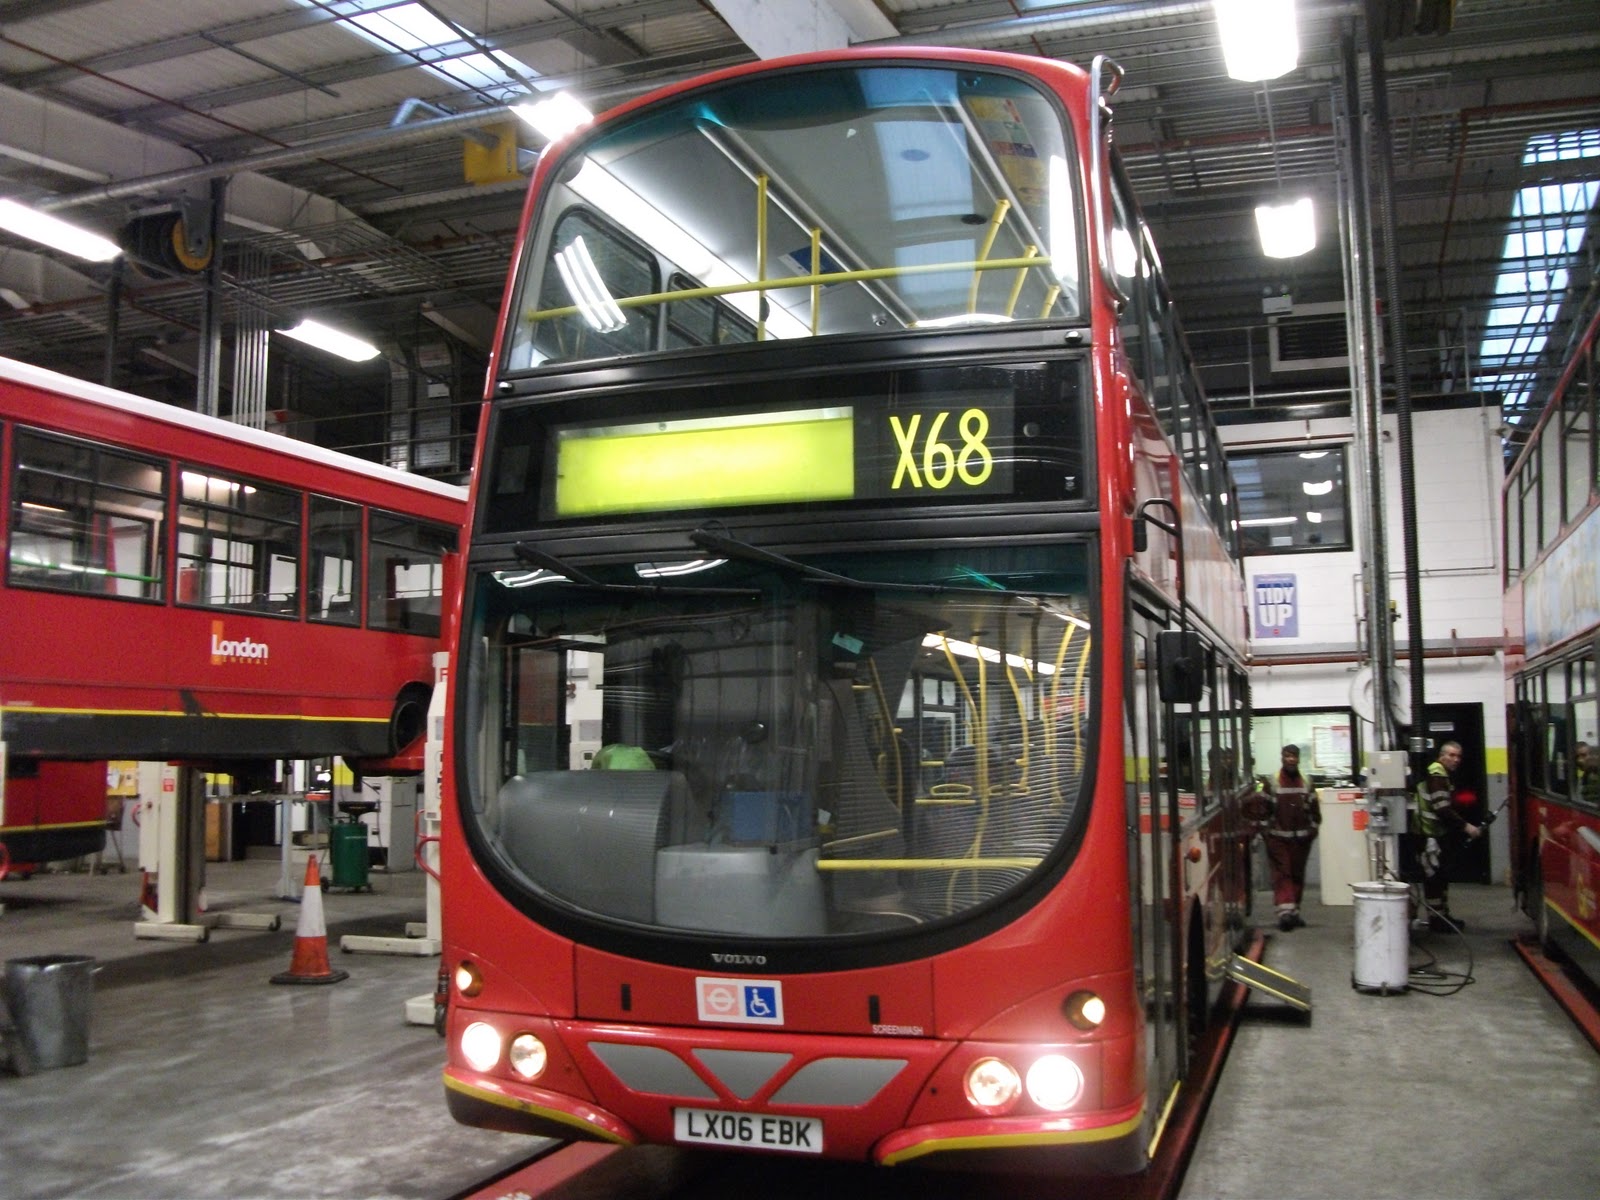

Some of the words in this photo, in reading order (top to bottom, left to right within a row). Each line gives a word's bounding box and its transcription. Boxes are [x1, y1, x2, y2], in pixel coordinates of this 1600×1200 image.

[889, 408, 993, 489] X68
[1256, 587, 1294, 604] TIDY
[1259, 605, 1293, 627] UP
[211, 633, 269, 659] London
[711, 953, 767, 965] VOLVO
[688, 1112, 753, 1142] LX06
[761, 1118, 811, 1147] EBK
